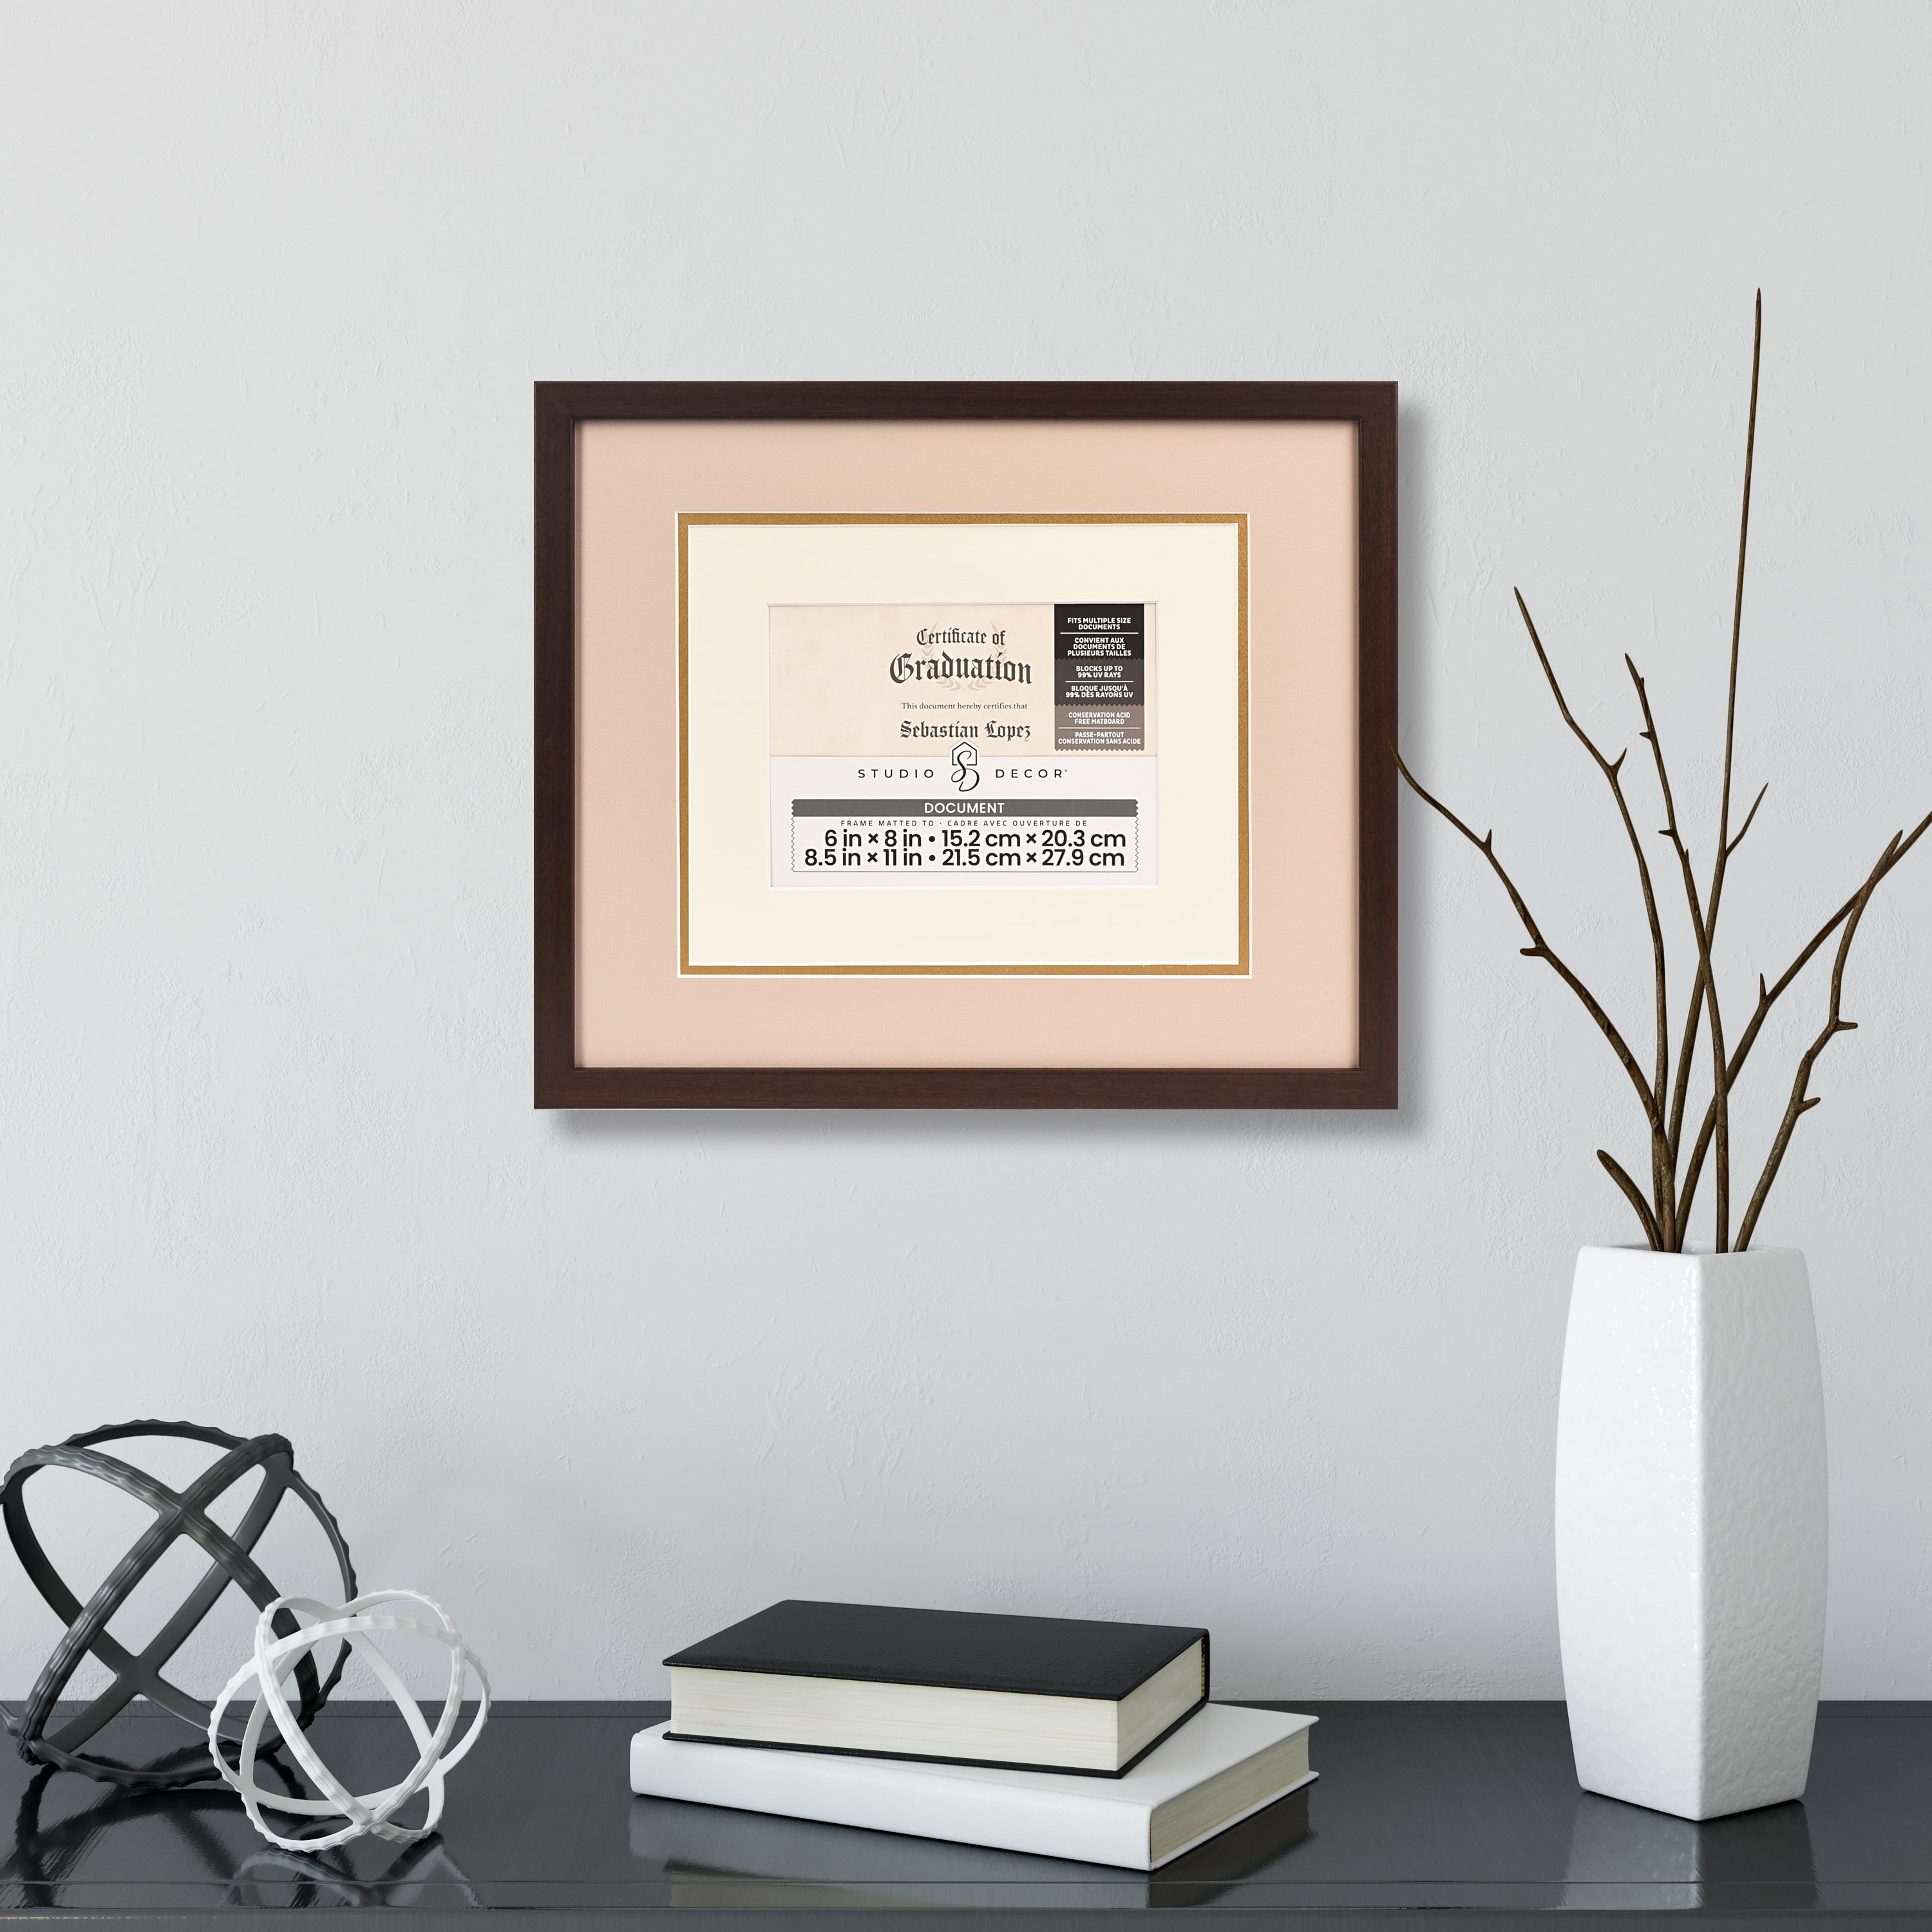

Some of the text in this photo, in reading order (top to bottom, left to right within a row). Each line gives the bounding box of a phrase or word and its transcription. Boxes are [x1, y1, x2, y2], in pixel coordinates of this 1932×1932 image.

[916, 627, 1007, 646] Certificate of
[889, 650, 1032, 685] Graduation
[957, 702, 981, 711] hereby
[900, 720, 1030, 742] Sebastian Lopez
[858, 769, 934, 779] STUDIO
[923, 802, 1005, 813] DOCUMENT
[824, 829, 837, 848] 6
[842, 828, 862, 847] in
[884, 829, 898, 848] 8
[903, 828, 922, 847] in
[942, 829, 980, 848] 15.2
[985, 833, 1021, 848] cm
[1041, 829, 1085, 848] 20.3
[1090, 833, 1126, 848] cm
[805, 848, 837, 867] 8.5
[842, 848, 861, 866] in
[883, 848, 898, 867] 11
[903, 848, 922, 866] in
[942, 848, 980, 867] 21.5
[985, 853, 1021, 867] cm
[1041, 848, 1083, 867] 27.9
[1088, 853, 1124, 867] cm
